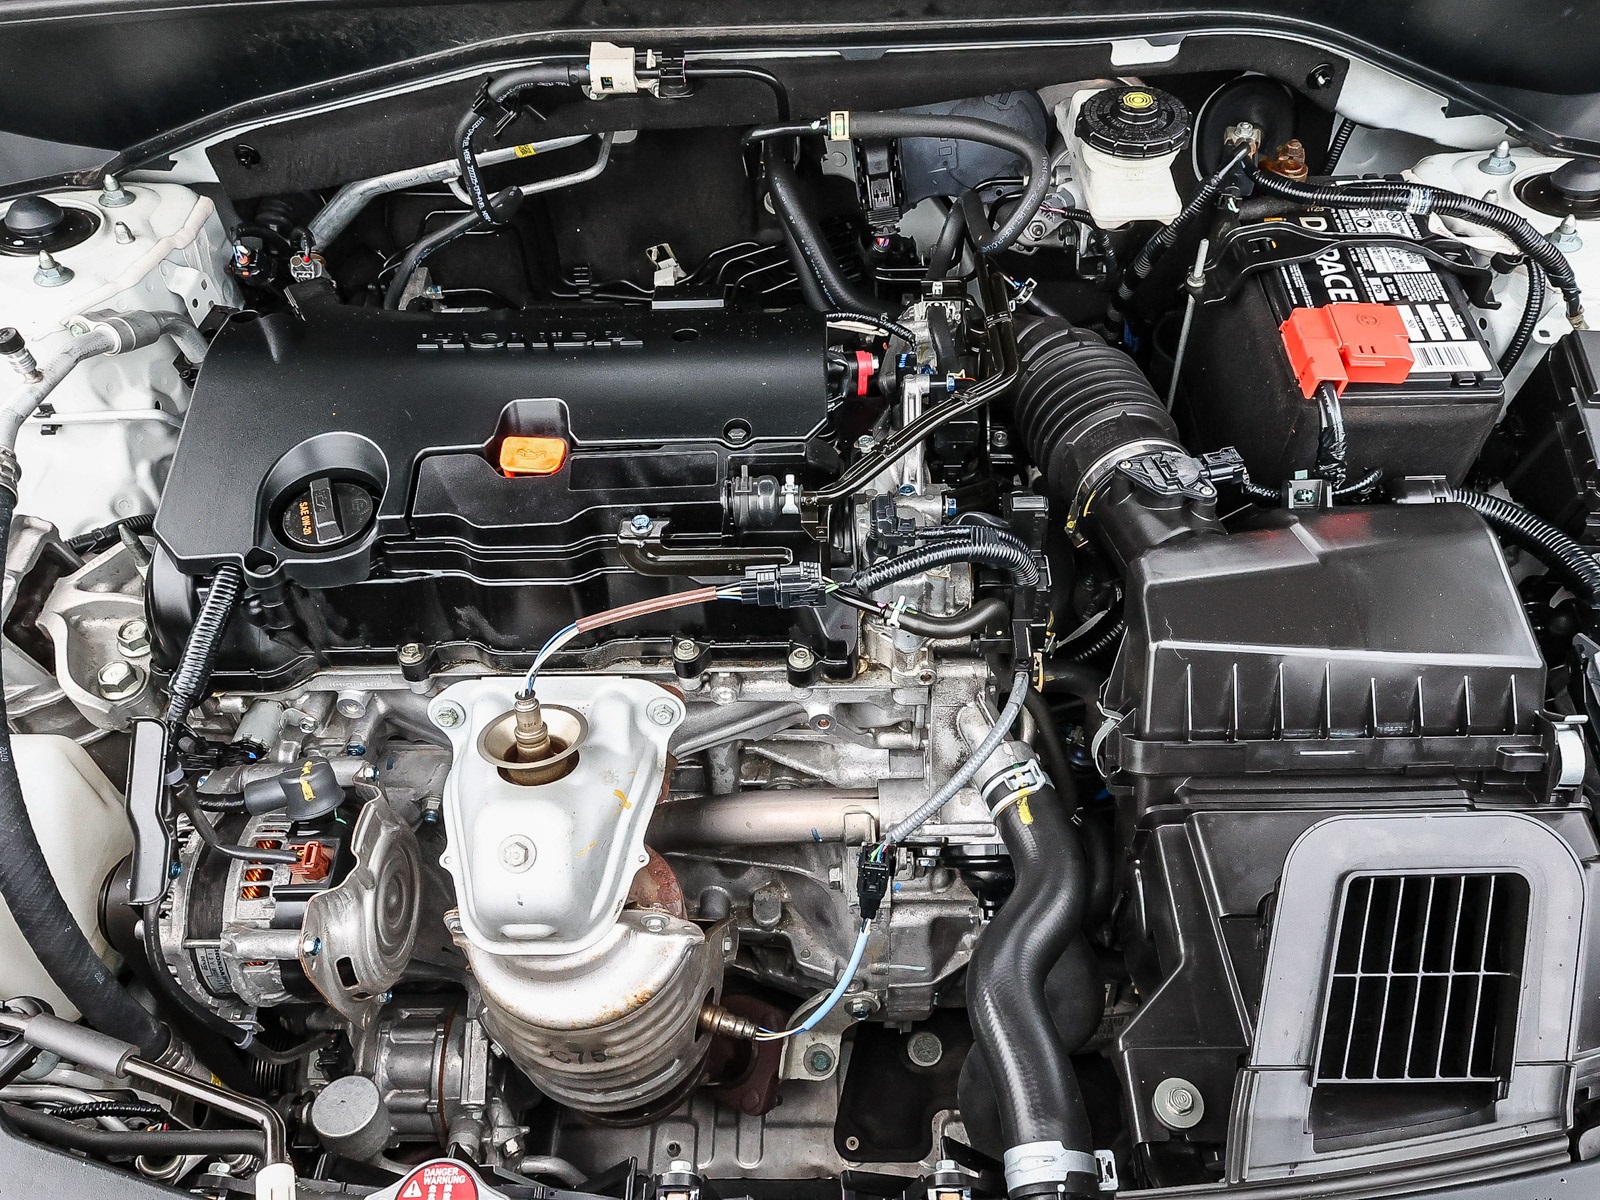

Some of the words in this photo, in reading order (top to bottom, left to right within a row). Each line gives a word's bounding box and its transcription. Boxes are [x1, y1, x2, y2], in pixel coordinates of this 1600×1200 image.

[1299, 217, 1360, 304] DRACE
[299, 501, 309, 516] SAE
[424, 1167, 459, 1177] DANGER
[424, 1175, 466, 1186] WARNUNG
